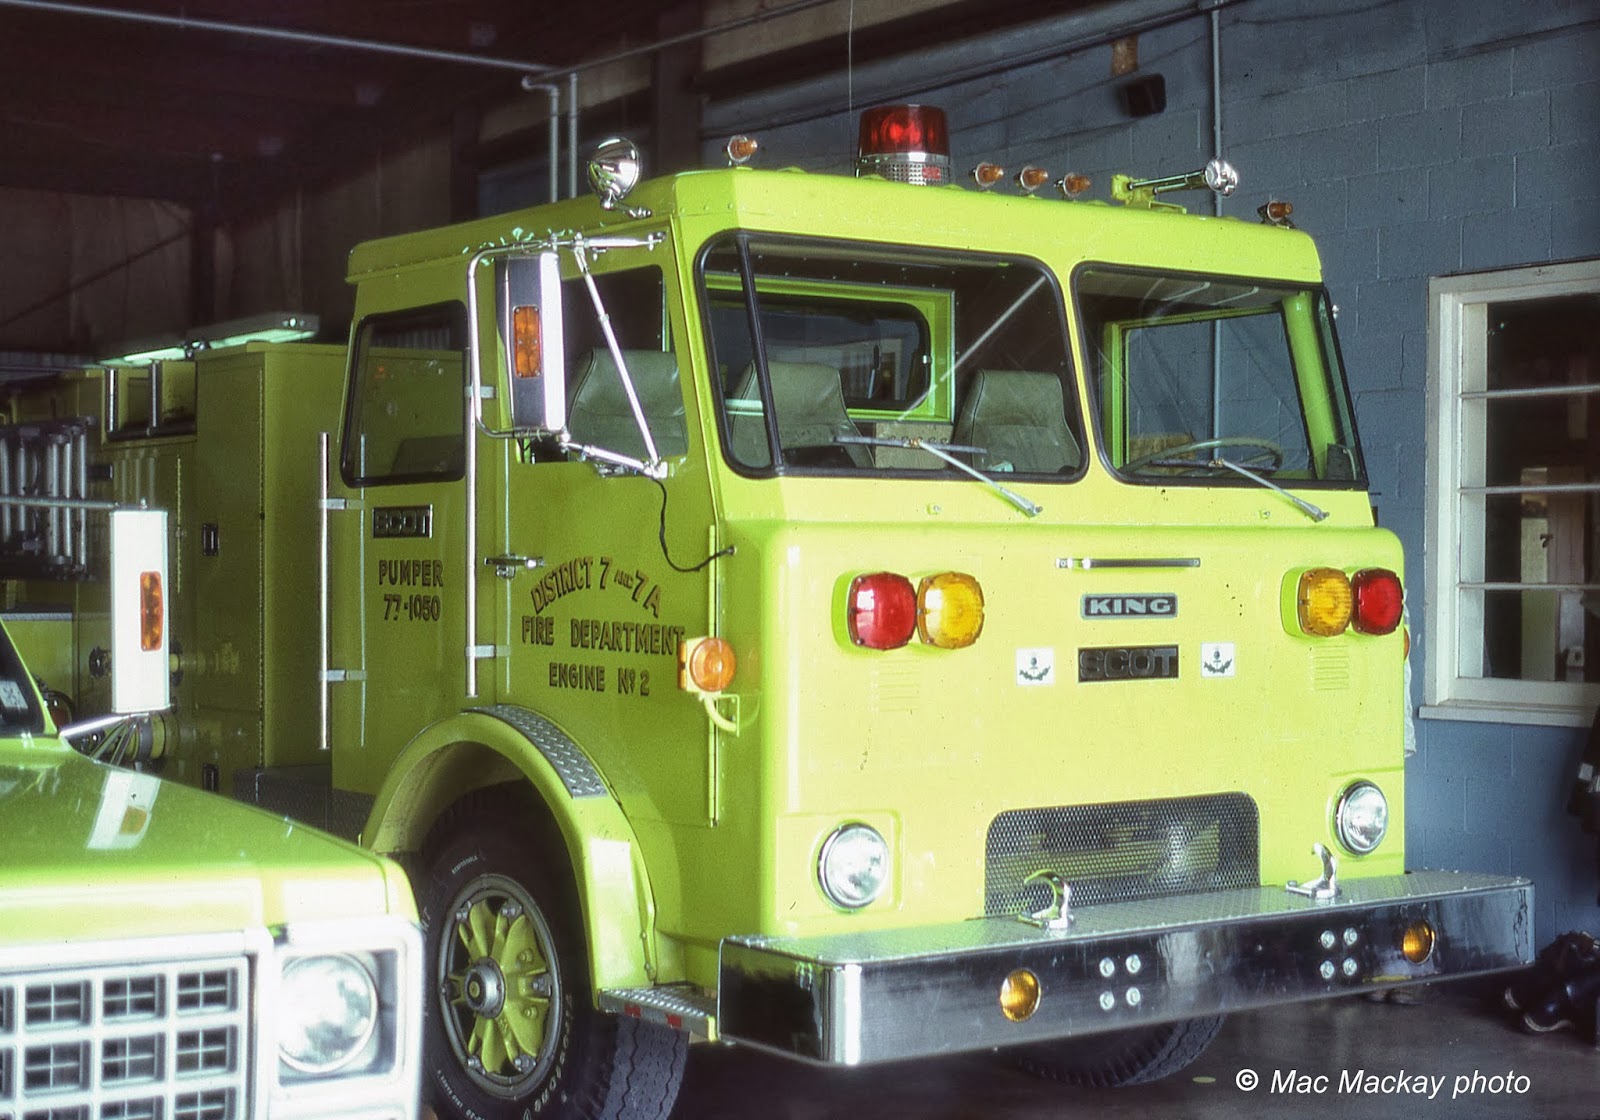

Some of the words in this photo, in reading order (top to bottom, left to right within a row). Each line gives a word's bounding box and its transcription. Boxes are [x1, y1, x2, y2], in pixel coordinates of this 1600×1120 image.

[379, 560, 443, 587] PUMPER
[530, 556, 593, 615] DISTRICT
[600, 556, 613, 590] 7
[384, 594, 440, 621] 77-1050
[1090, 598, 1171, 614] KING
[522, 616, 554, 646] FIRE
[571, 618, 685, 656] DEPARTMENT
[1079, 647, 1177, 678] SCOT
[549, 662, 605, 692] ENGINE
[640, 669, 650, 696] 2
